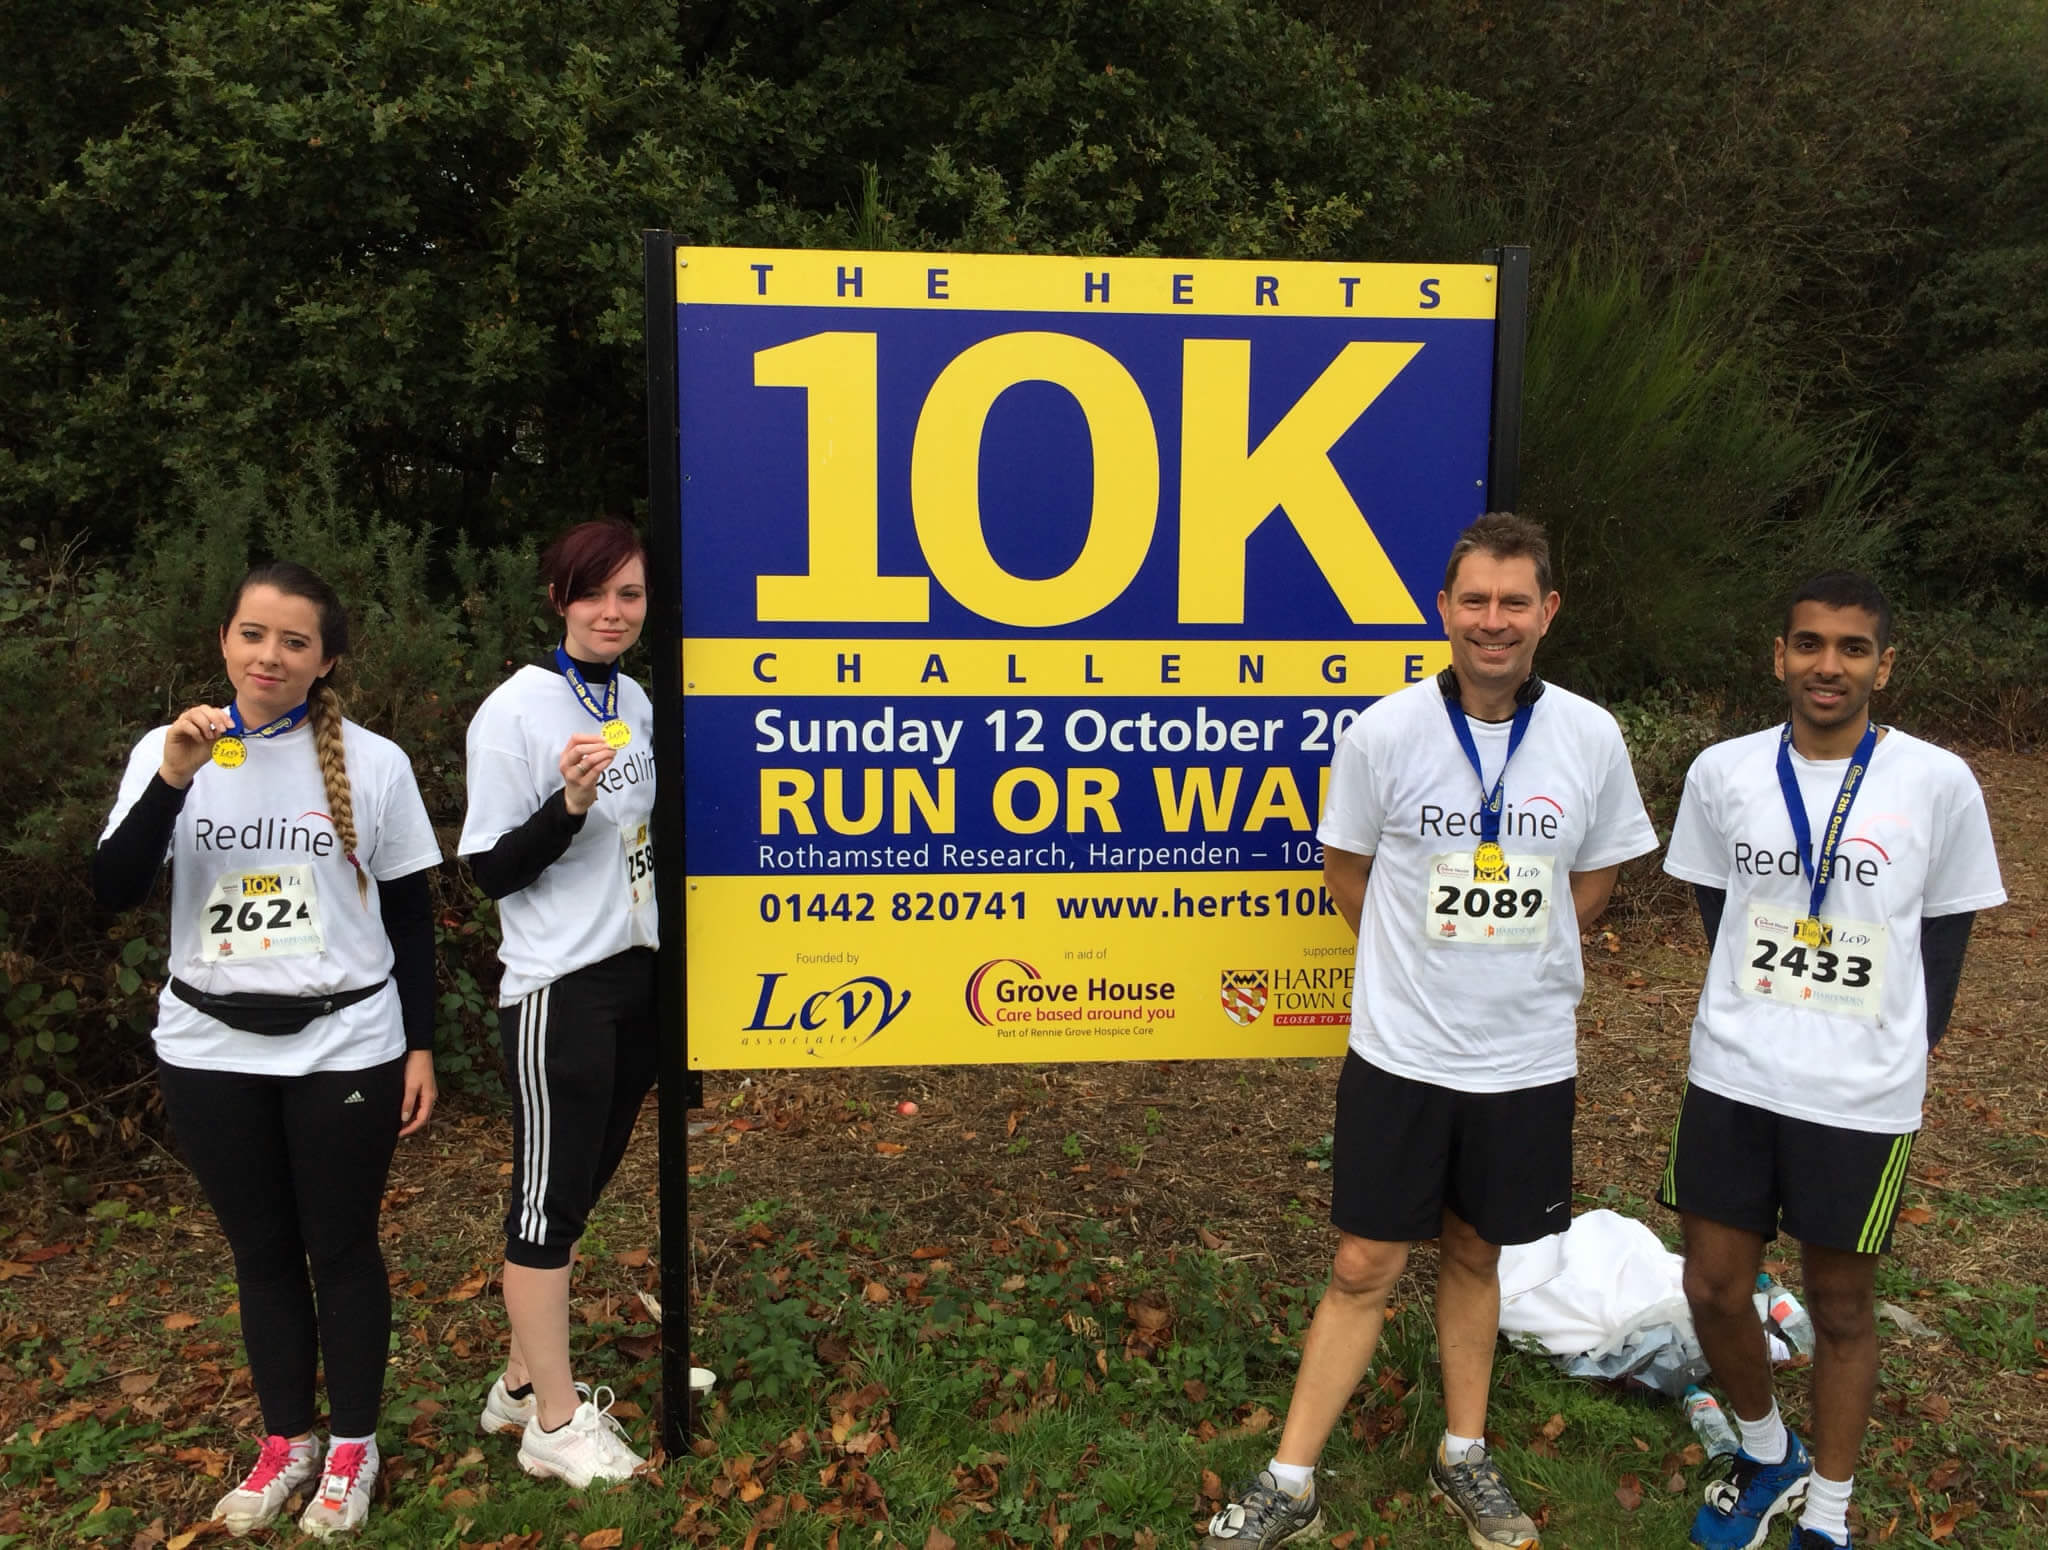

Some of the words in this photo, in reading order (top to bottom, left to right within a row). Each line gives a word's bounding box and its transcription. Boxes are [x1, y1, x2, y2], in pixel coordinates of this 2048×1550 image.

[750, 264, 950, 299] THE
[1084, 272, 1441, 309] HERTS
[754, 331, 1427, 627] 10K
[752, 652, 1424, 684] CHALLENGE
[755, 707, 963, 765] Sunday
[985, 709, 1044, 751] 12
[1065, 707, 1284, 752] October
[760, 768, 956, 835] RUN
[992, 767, 1121, 834] OR
[1835, 792, 1852, 814] 12th
[194, 817, 334, 857] Redline
[1420, 803, 1558, 840] Reine
[1825, 815, 1843, 857] October
[760, 843, 930, 869] Rothamsted
[943, 842, 1074, 870] Research,
[1090, 840, 1240, 870] Harpenden
[1735, 842, 1879, 887] Redne
[243, 877, 280, 894] 10K
[760, 892, 875, 923] 01442
[892, 891, 1027, 922] 820741
[1435, 885, 1544, 918] 2089
[796, 952, 844, 965] Founded
[847, 952, 860, 966] by
[1064, 950, 1074, 960] in
[1078, 949, 1093, 960] aid
[1096, 948, 1108, 960] of
[1303, 945, 1355, 958] supported
[1751, 939, 1873, 988] 2433
[996, 979, 1078, 1003] Grove
[1088, 977, 1175, 1002] House
[1273, 992, 1336, 1010] TOWN
[996, 1007, 1032, 1022] Care
[1036, 1006, 1083, 1022] based
[1087, 1005, 1143, 1021] around
[1147, 1008, 1175, 1023] you
[1275, 1015, 1317, 1025] CLOSER
[1320, 1015, 1335, 1024] TO
[741, 1034, 858, 1046] associates
[997, 1028, 1016, 1038] Part
[1019, 1027, 1029, 1038] of
[1031, 1027, 1063, 1037] Rennie
[1065, 1027, 1092, 1037] Grove
[1094, 1026, 1131, 1038] Hospice
[1133, 1025, 1154, 1036] Care
